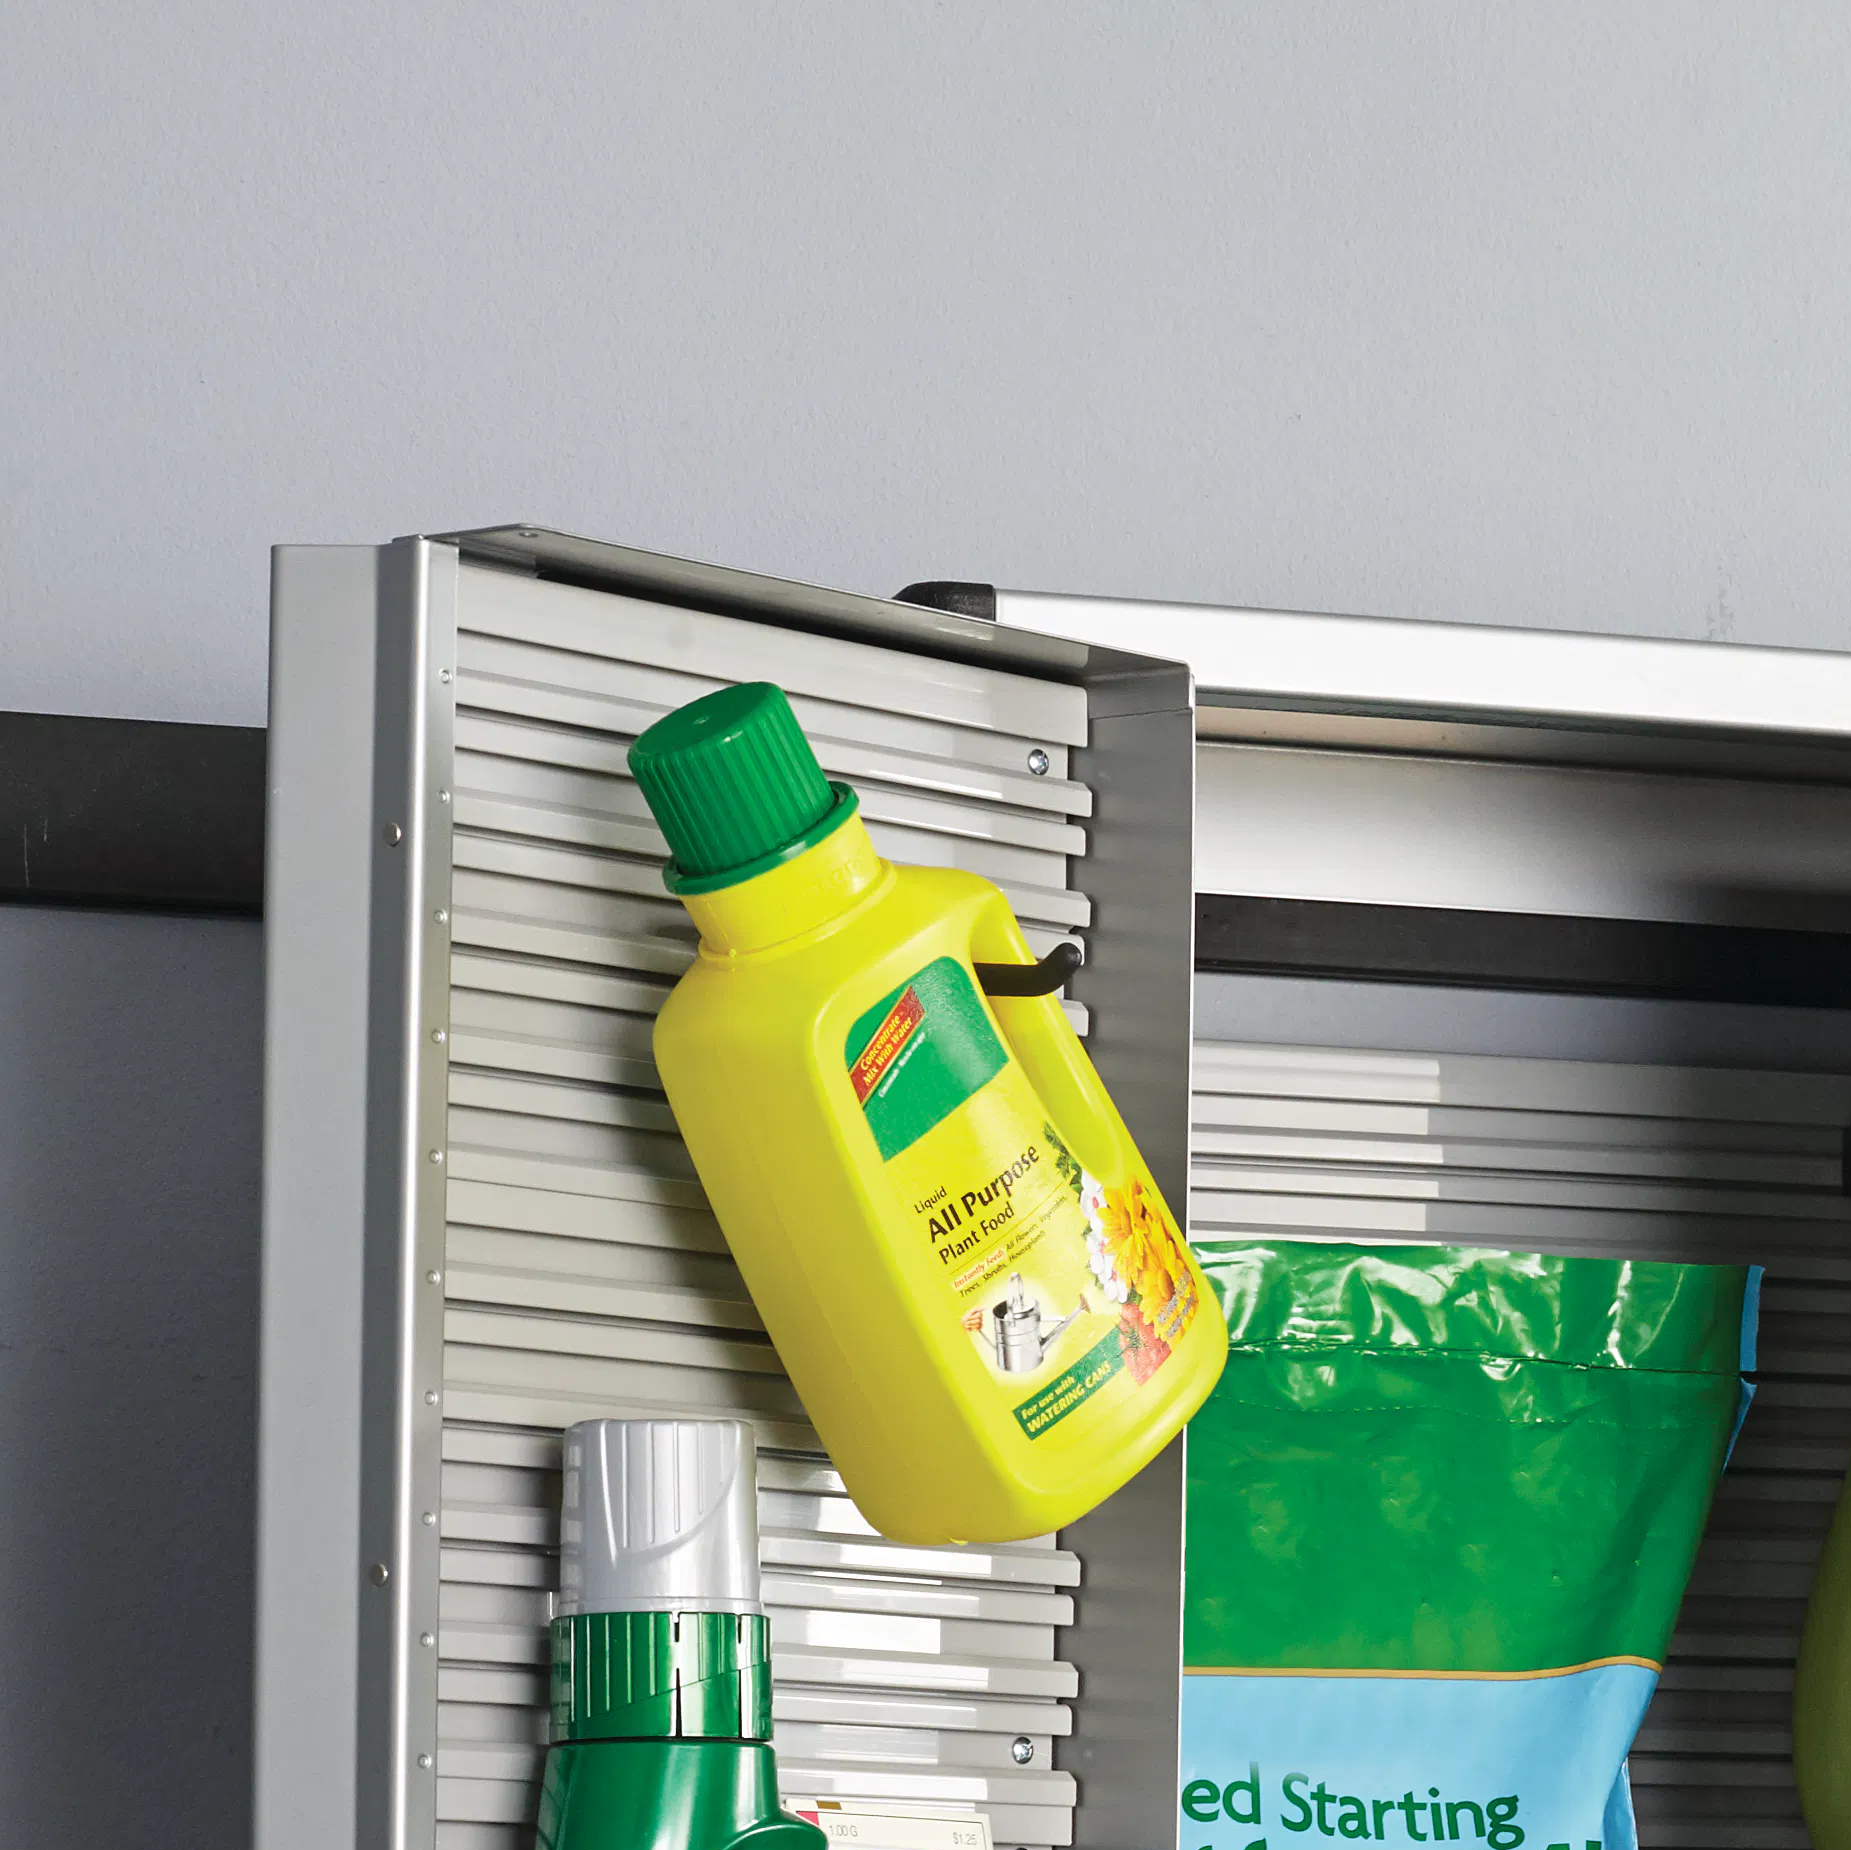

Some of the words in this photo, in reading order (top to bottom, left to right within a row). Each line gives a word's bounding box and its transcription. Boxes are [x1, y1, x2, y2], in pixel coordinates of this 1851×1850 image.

[860, 1015, 900, 1071] Concentrate
[863, 1066, 878, 1086] Mix
[876, 1041, 894, 1066] With
[891, 1017, 913, 1044] Water
[914, 1186, 947, 1214] Liquid
[929, 1203, 962, 1243] All
[961, 1146, 1039, 1217] Purpose
[939, 1230, 980, 1264] Plant
[980, 1201, 1015, 1236] Food
[954, 1264, 985, 1288] Instantly
[1021, 1405, 1038, 1420] For
[1038, 1390, 1054, 1409] use
[1056, 1375, 1075, 1395] with
[1026, 1384, 1085, 1432] WATERING
[1085, 1361, 1112, 1388] CANS
[829, 1825, 849, 1837] 1.00
[850, 1825, 858, 1837] G
[1181, 1761, 1260, 1825] ed
[1281, 1772, 1524, 1850] Starting
[953, 1832, 977, 1846] $1.25
